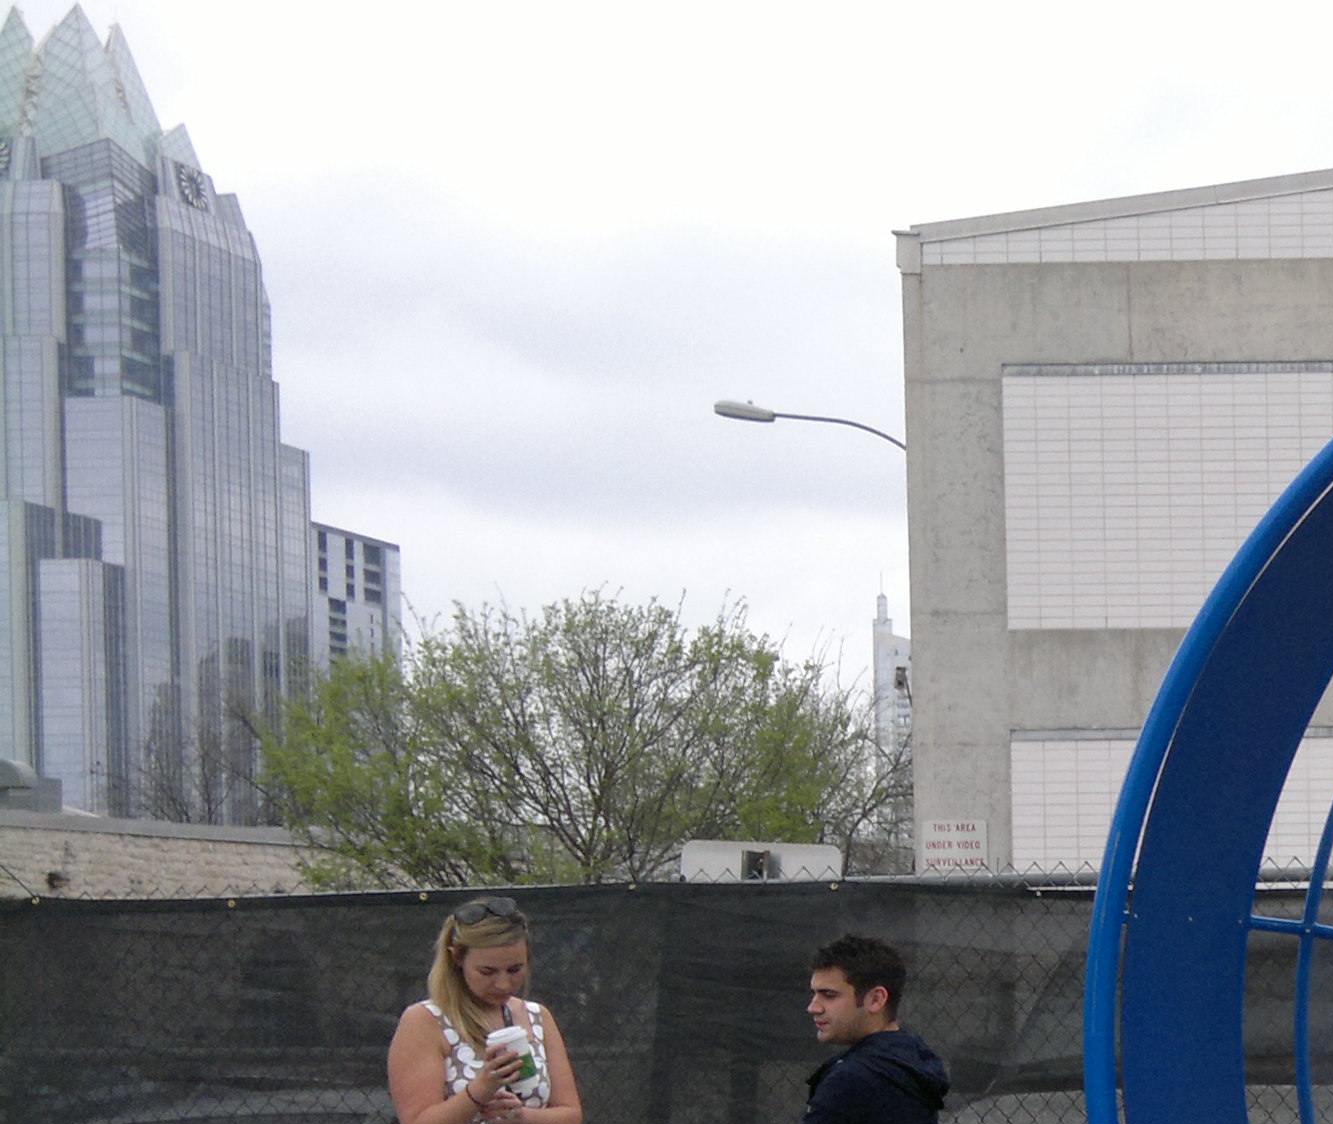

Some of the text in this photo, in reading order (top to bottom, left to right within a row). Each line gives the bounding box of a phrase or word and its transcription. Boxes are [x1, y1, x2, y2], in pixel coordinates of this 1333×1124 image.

[933, 823, 977, 832] THIS AREA
[926, 840, 981, 850] UNDER VIDEO
[926, 857, 984, 867] SURVEILLANCE
